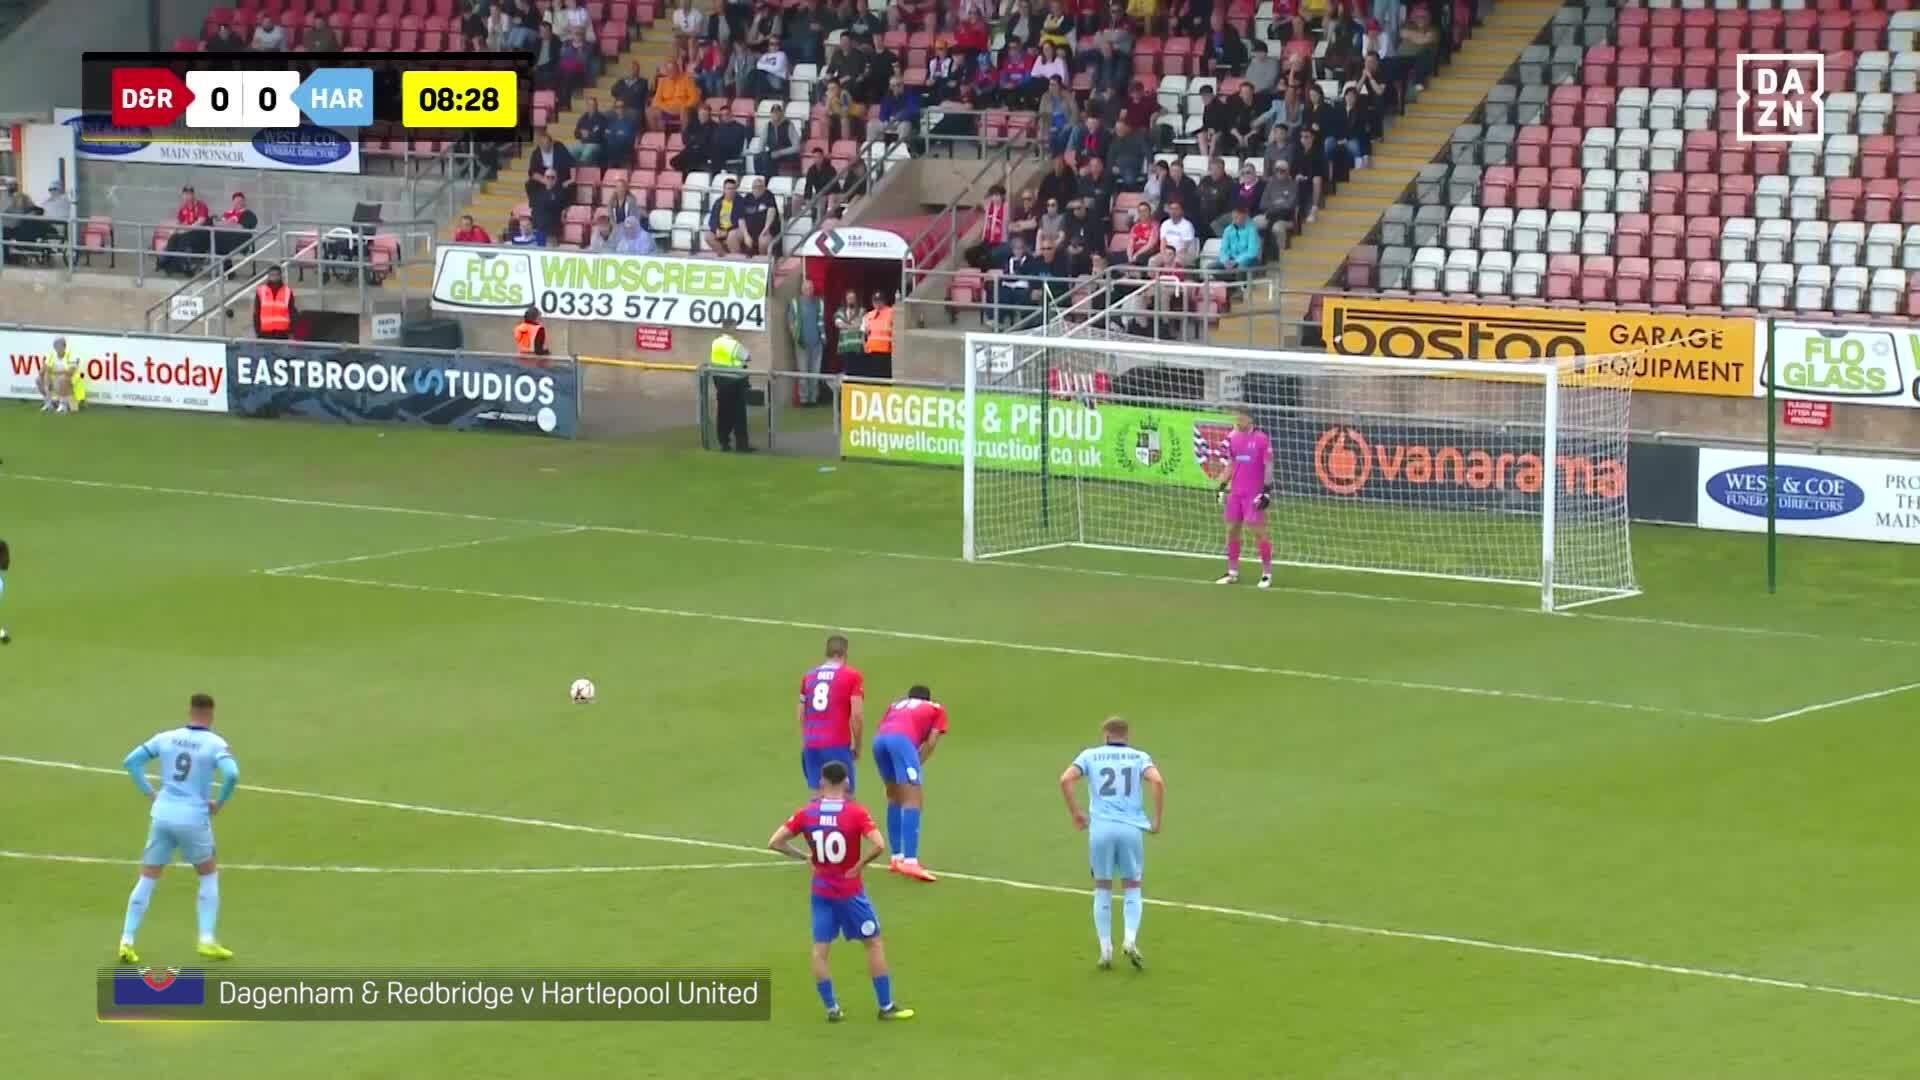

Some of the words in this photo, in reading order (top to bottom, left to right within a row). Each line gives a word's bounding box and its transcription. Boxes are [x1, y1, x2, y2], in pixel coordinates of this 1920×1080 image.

[466, 257, 509, 283] FLO
[540, 255, 766, 299] WINDSCREENS
[449, 279, 524, 305] GLASS
[541, 290, 613, 318] 0333
[623, 295, 679, 322] 577
[689, 299, 764, 328] 6004
[1333, 307, 1586, 374] boston
[1609, 323, 1724, 350] GARAGE
[1805, 336, 1865, 366] FLO
[10, 352, 223, 395] ww.oils.today
[237, 356, 407, 394] EASTBROOK
[414, 366, 555, 405] STUDIOS
[1782, 361, 1887, 392] GLASS
[850, 390, 966, 431] DAGGERS
[982, 402, 1003, 433] &
[1375, 443, 1625, 499] vanarama
[1726, 473, 1779, 491] WES
[1783, 476, 1801, 494] &
[1805, 477, 1845, 496] COE
[1726, 493, 1769, 507] FUNERA
[1778, 496, 1844, 512] DIRECTORS
[813, 682, 829, 711] 8
[173, 752, 192, 782] 9
[1100, 766, 1132, 798] 21
[811, 829, 846, 864] 10
